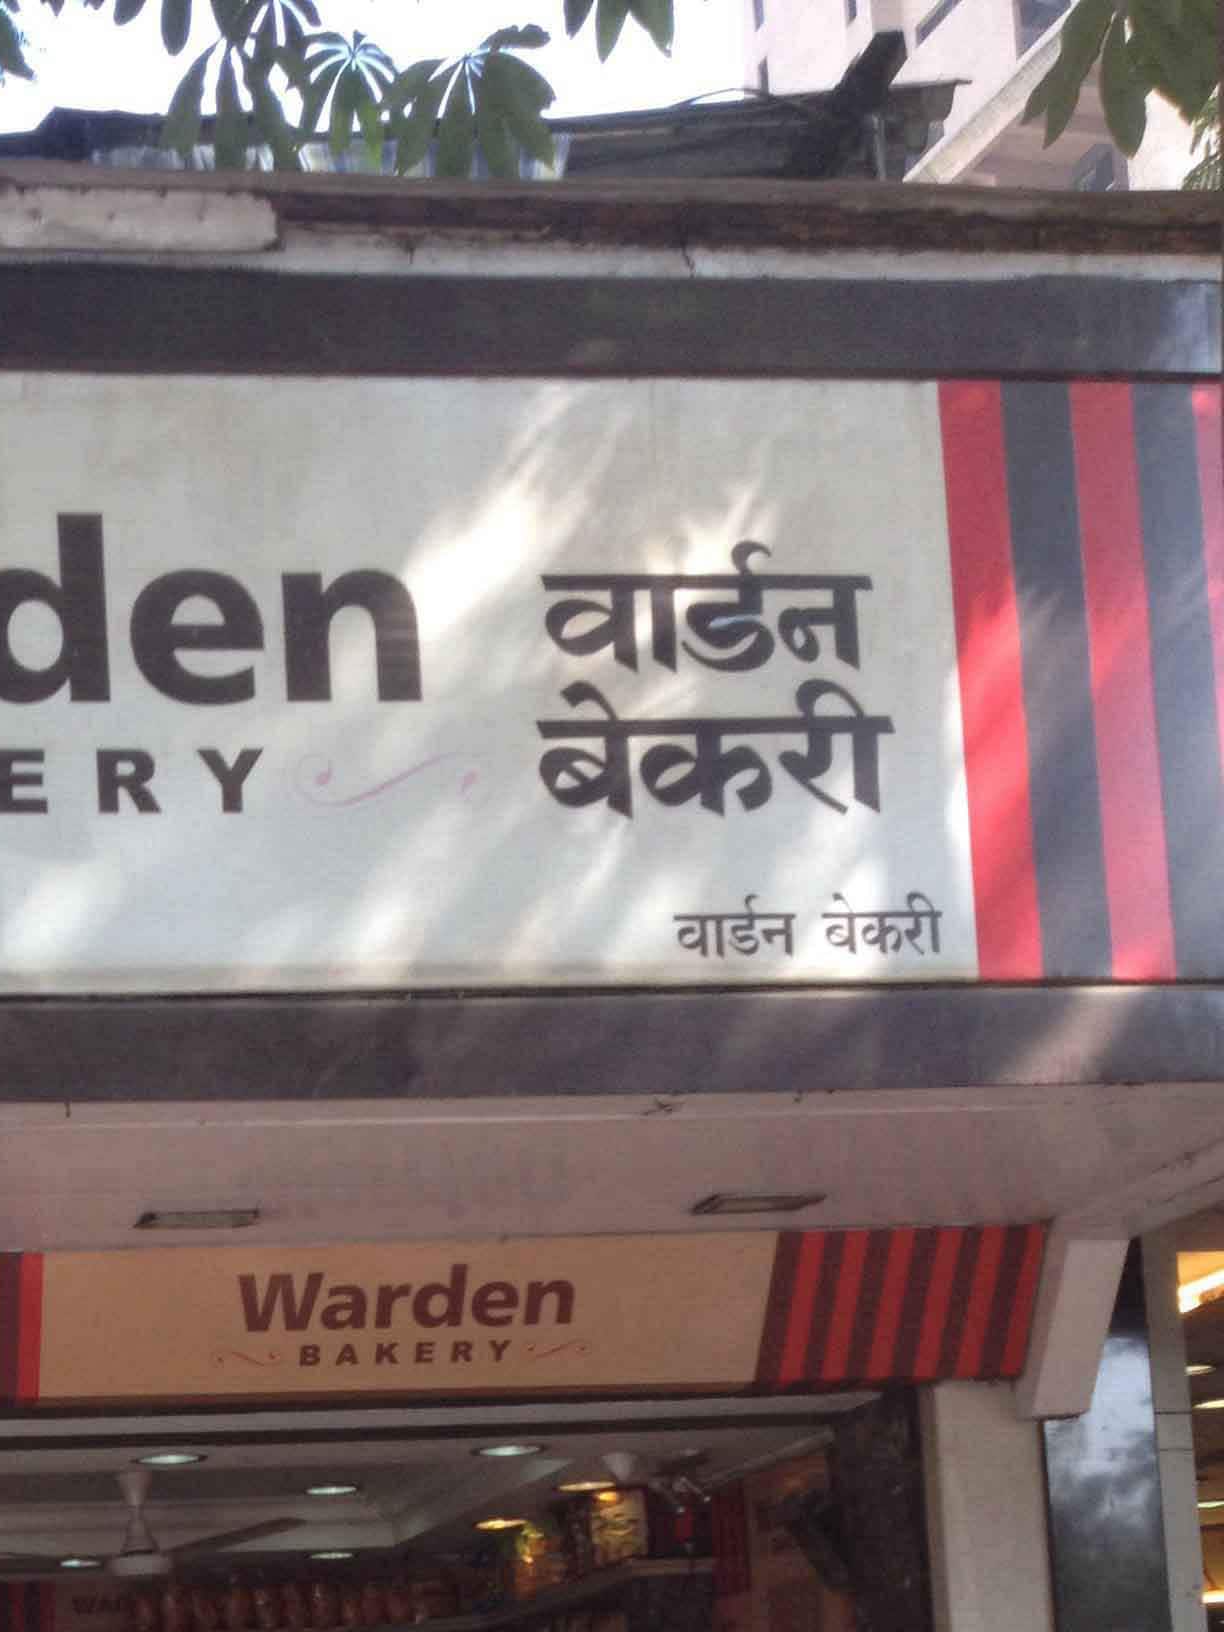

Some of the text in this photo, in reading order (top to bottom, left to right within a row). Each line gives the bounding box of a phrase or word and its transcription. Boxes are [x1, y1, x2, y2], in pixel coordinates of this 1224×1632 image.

[540, 540, 874, 673] वार्डन
[535, 678, 896, 819] बेकरी
[673, 893, 796, 958] वार्डन
[237, 1263, 576, 1333] Warden
[298, 1339, 512, 1367] BAKERY
